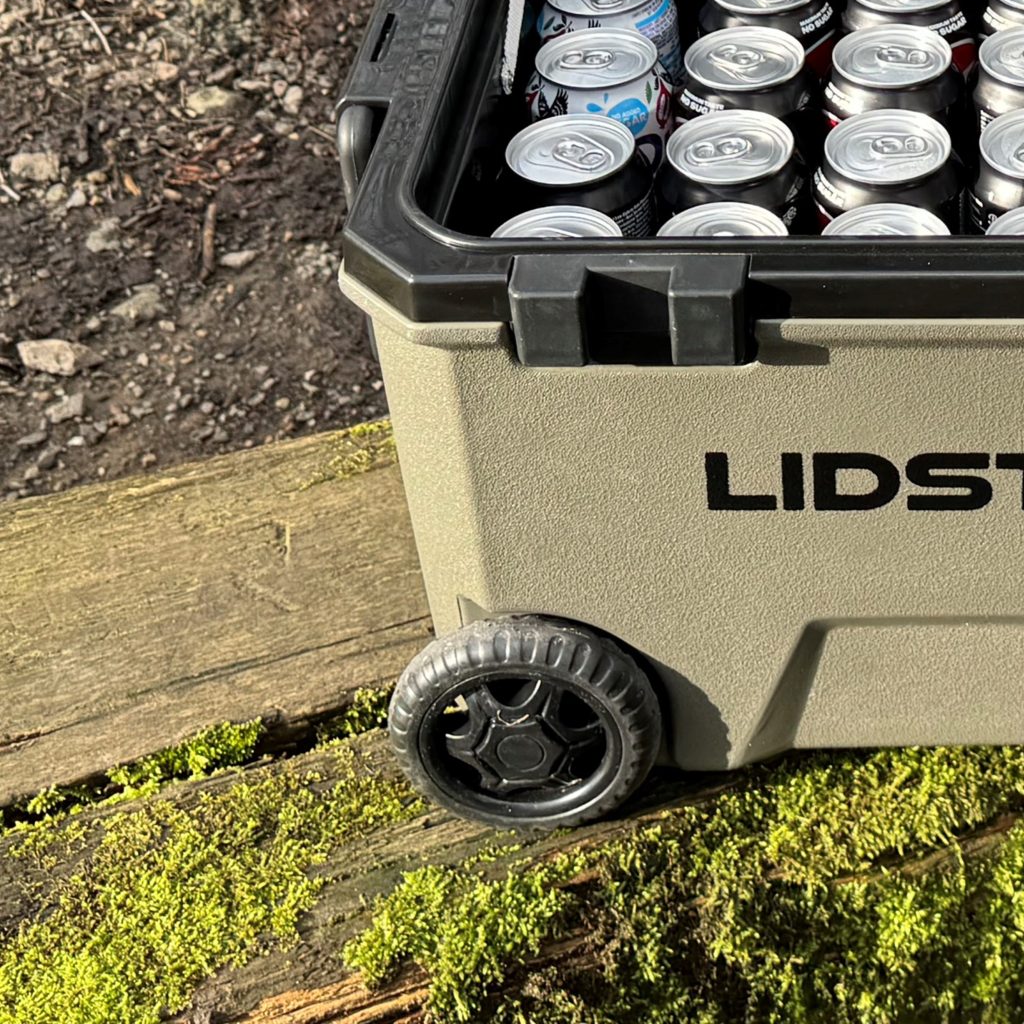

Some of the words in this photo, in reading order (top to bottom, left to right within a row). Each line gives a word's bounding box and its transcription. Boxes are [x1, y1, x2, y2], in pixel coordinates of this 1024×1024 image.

[801, 23, 816, 35] NO
[814, 6, 834, 29] SUGAR
[939, 16, 968, 36] SUGAR
[689, 101, 715, 115] SUG
